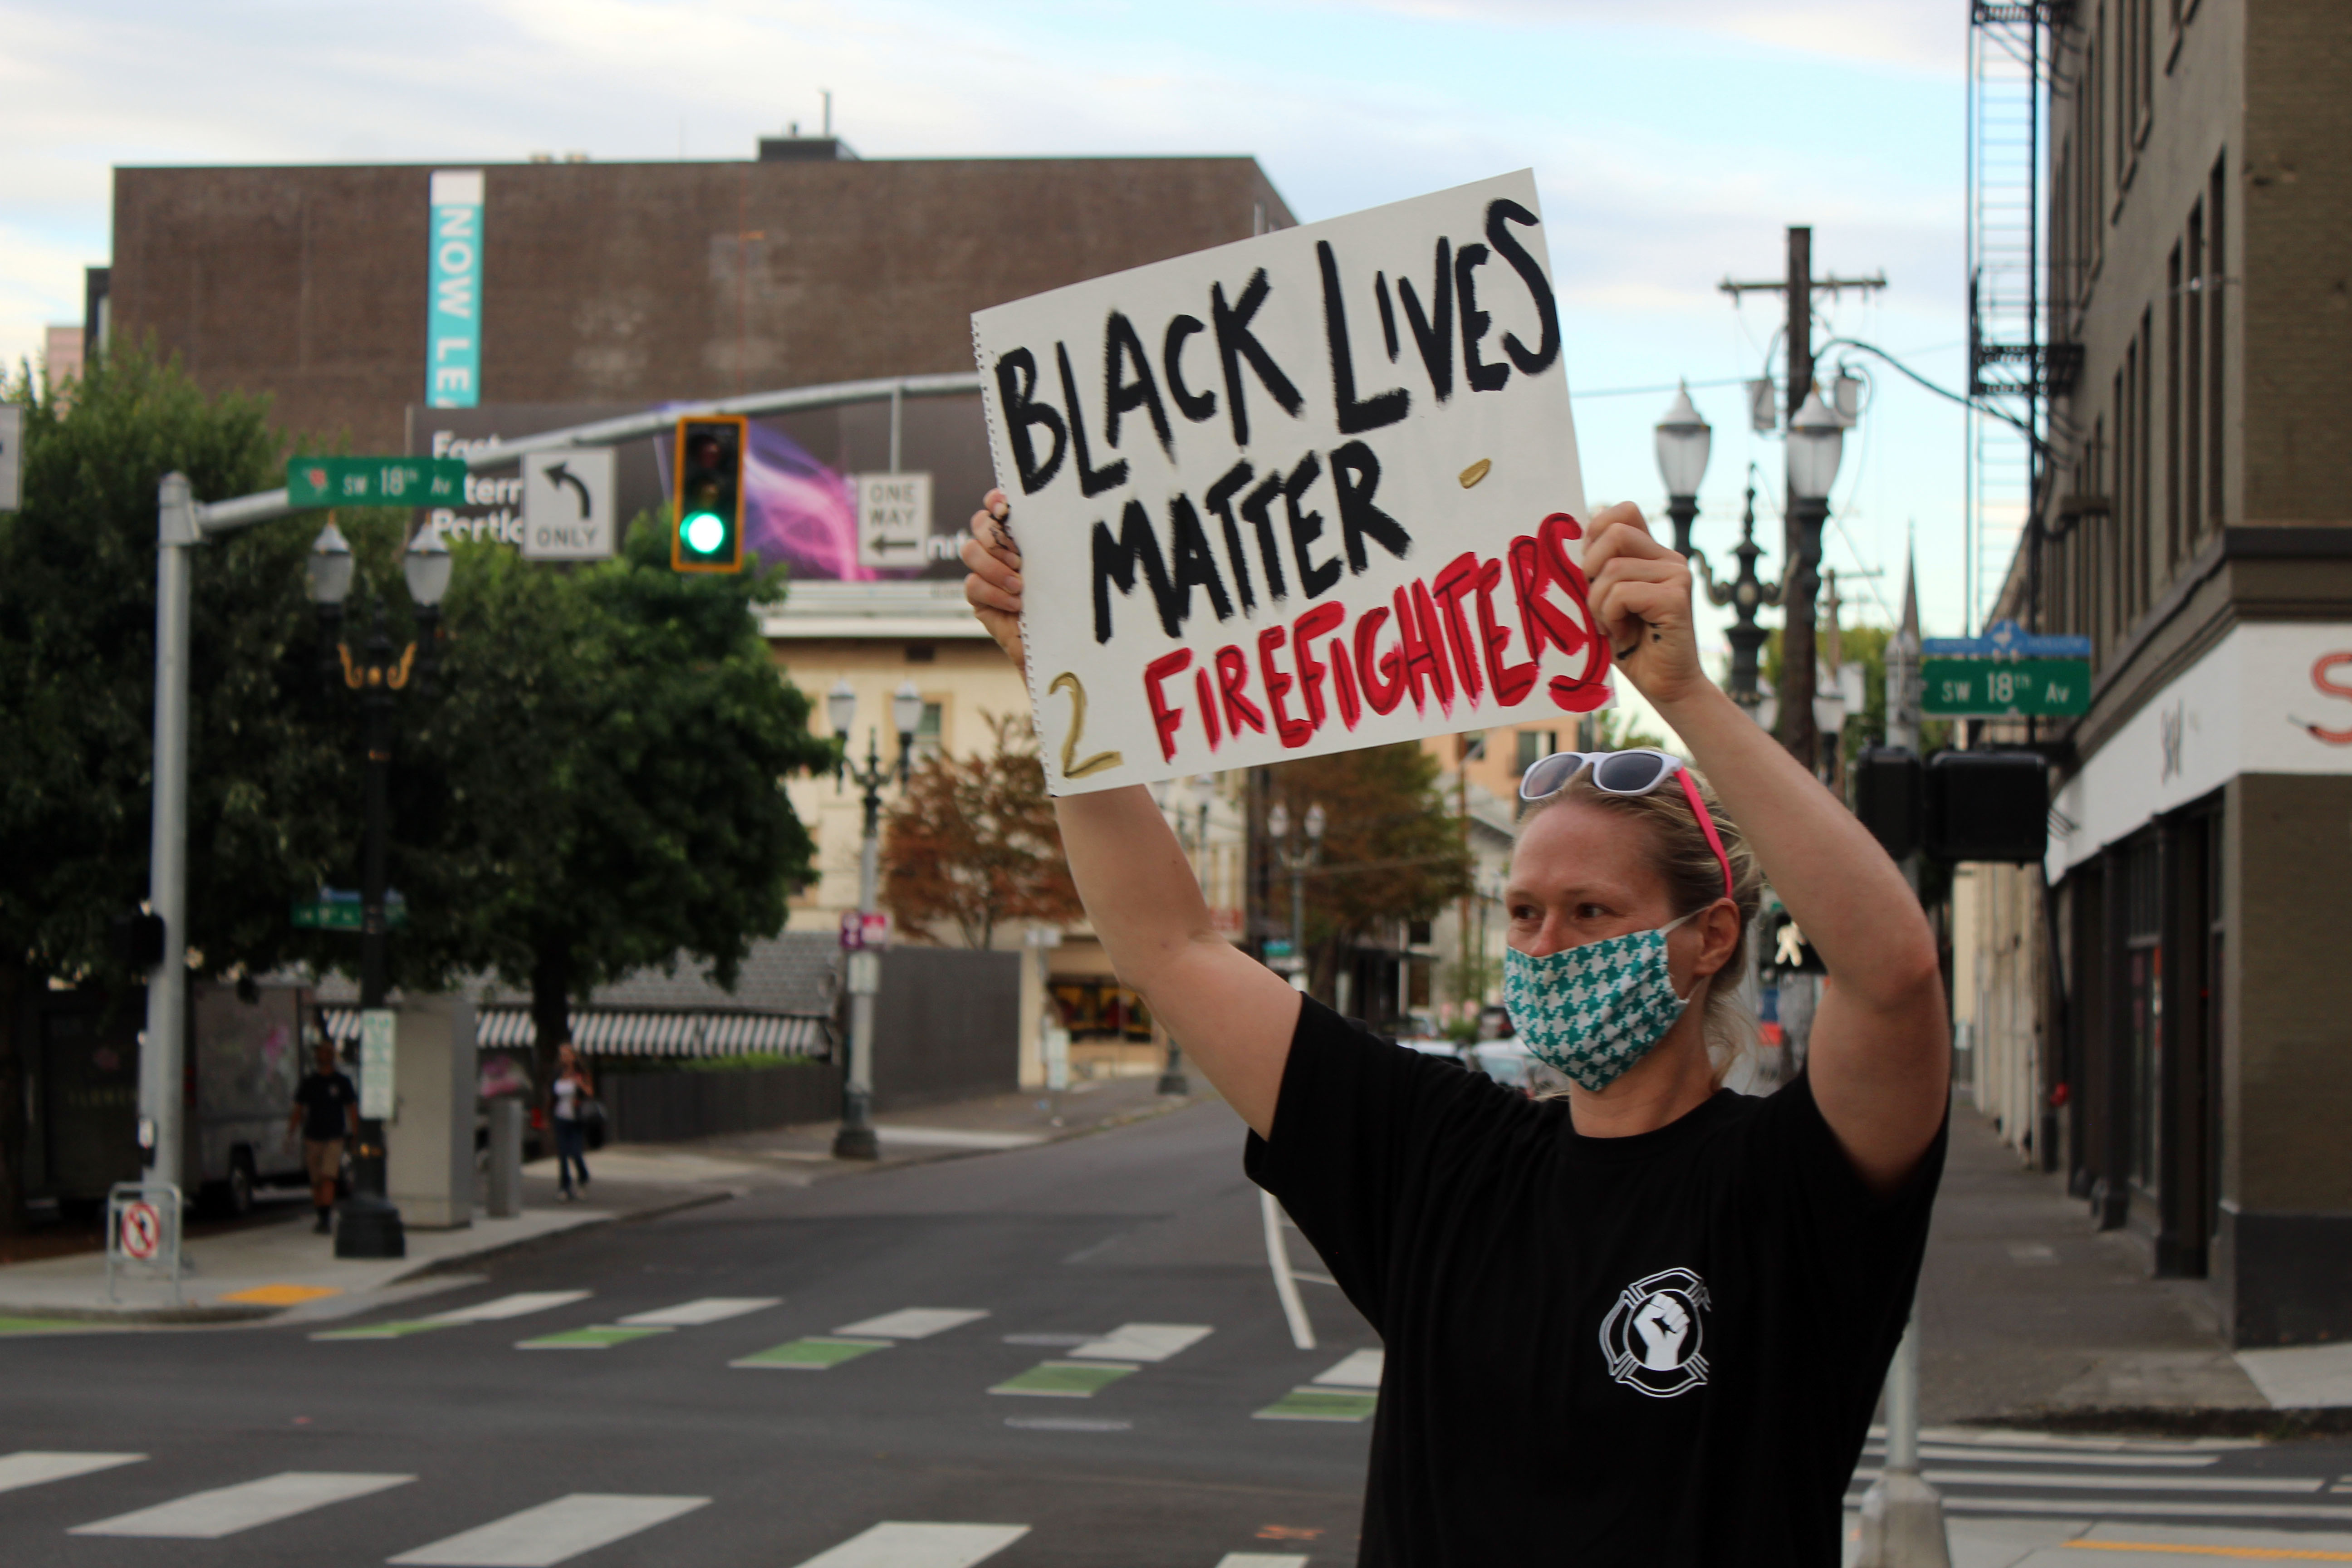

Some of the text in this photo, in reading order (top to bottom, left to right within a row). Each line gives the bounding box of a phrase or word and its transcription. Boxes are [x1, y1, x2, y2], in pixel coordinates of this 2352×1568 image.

[436, 208, 473, 407] NOW LE
[995, 197, 1561, 497] BLACK LIVES
[343, 474, 368, 496] SW
[869, 483, 916, 503] ONE
[868, 507, 916, 527] WAY
[537, 527, 598, 547] ONLY
[1092, 440, 1412, 645] MATTER
[1049, 512, 1615, 779] 2 FIREFIGHTERS
[1941, 681, 1971, 703] SW
[2045, 682, 2070, 704] Av
